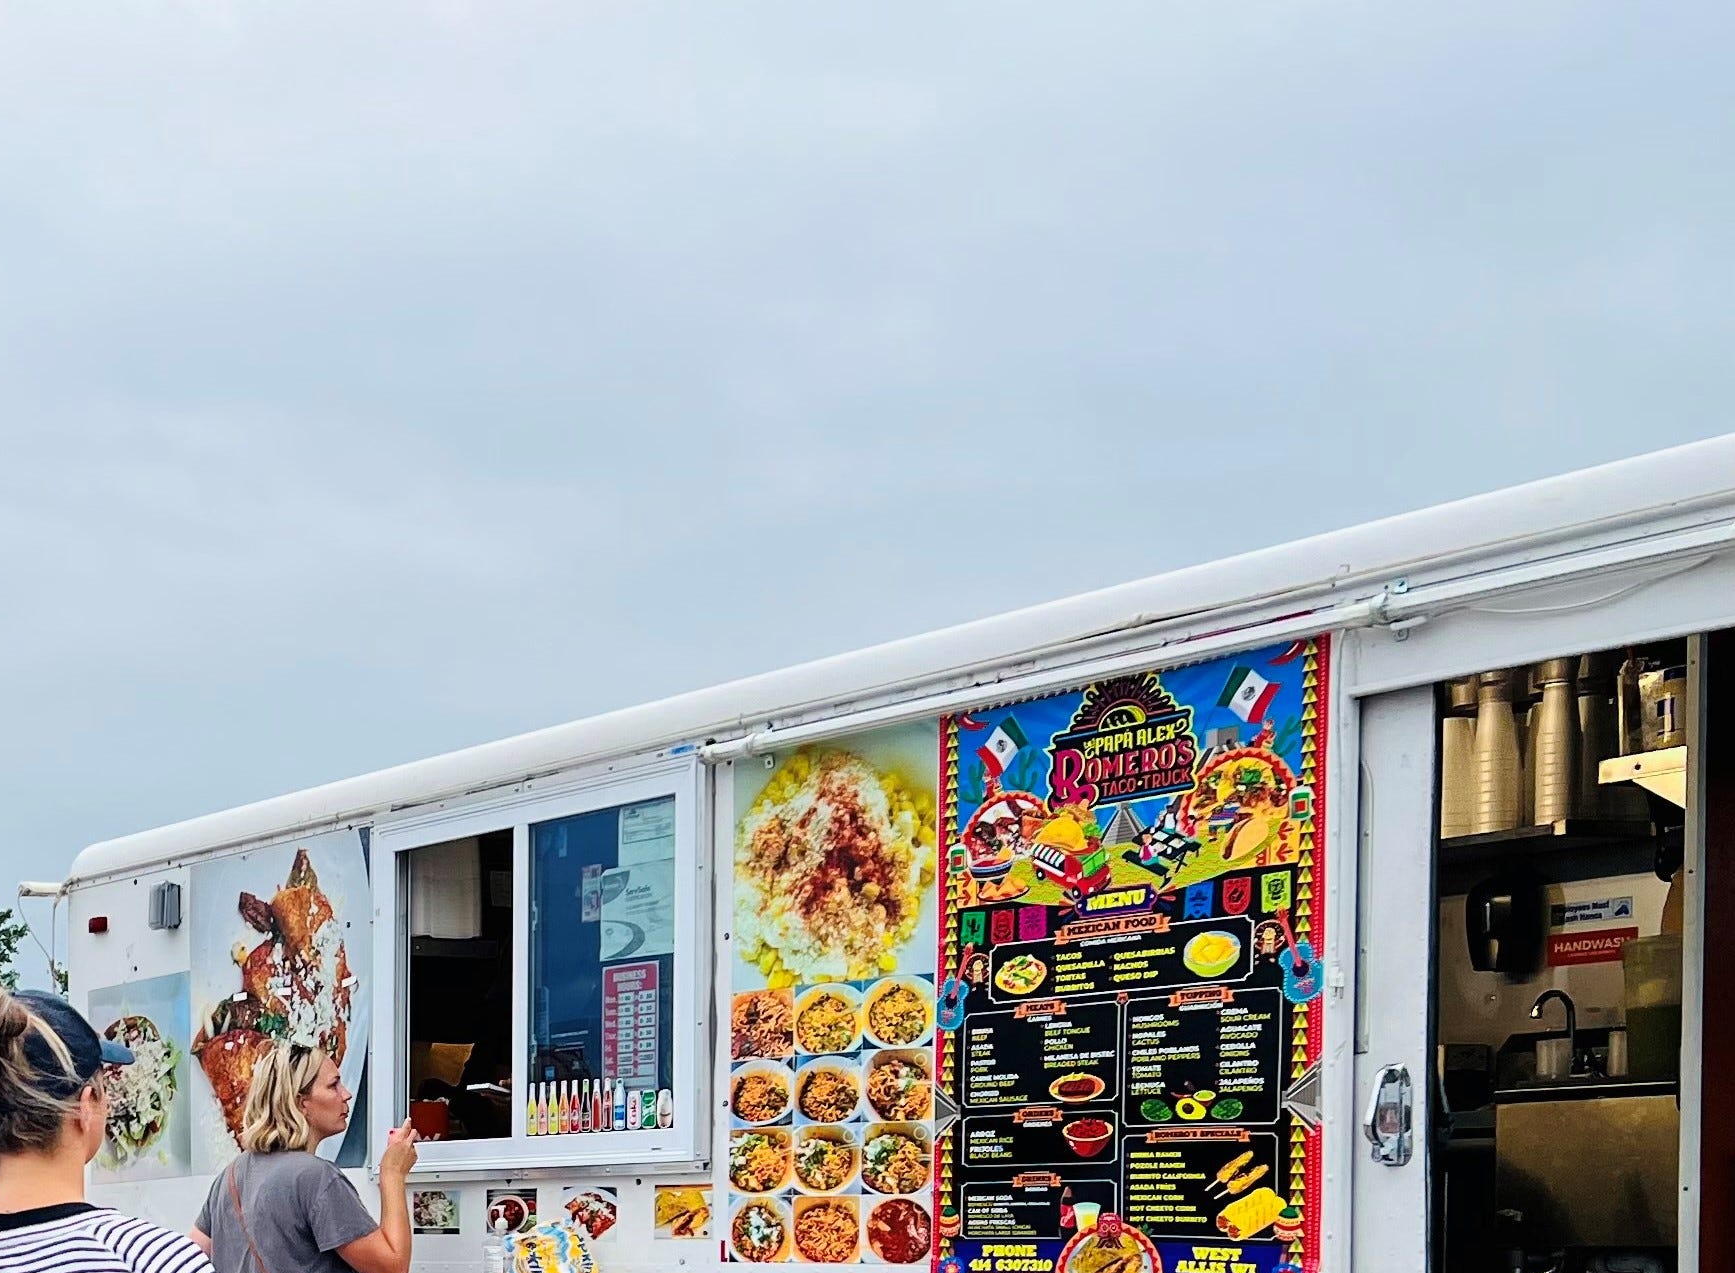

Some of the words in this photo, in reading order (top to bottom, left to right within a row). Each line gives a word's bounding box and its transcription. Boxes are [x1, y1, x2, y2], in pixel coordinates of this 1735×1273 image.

[1137, 722, 1176, 747] ALEX
[1051, 739, 1195, 808] ROMERO'S
[1101, 778, 1137, 797] TACO
[1143, 768, 1191, 789] TRUCK
[1086, 889, 1146, 911] MENU
[1066, 920, 1121, 937] MEXICAN
[1125, 916, 1157, 930] FOOD
[1055, 952, 1082, 961] TACOS
[981, 1244, 1037, 1257] PHONE
[1192, 1246, 1242, 1262] WEST
[968, 1258, 992, 1271] 414
[996, 1258, 1053, 1272] 6307310
